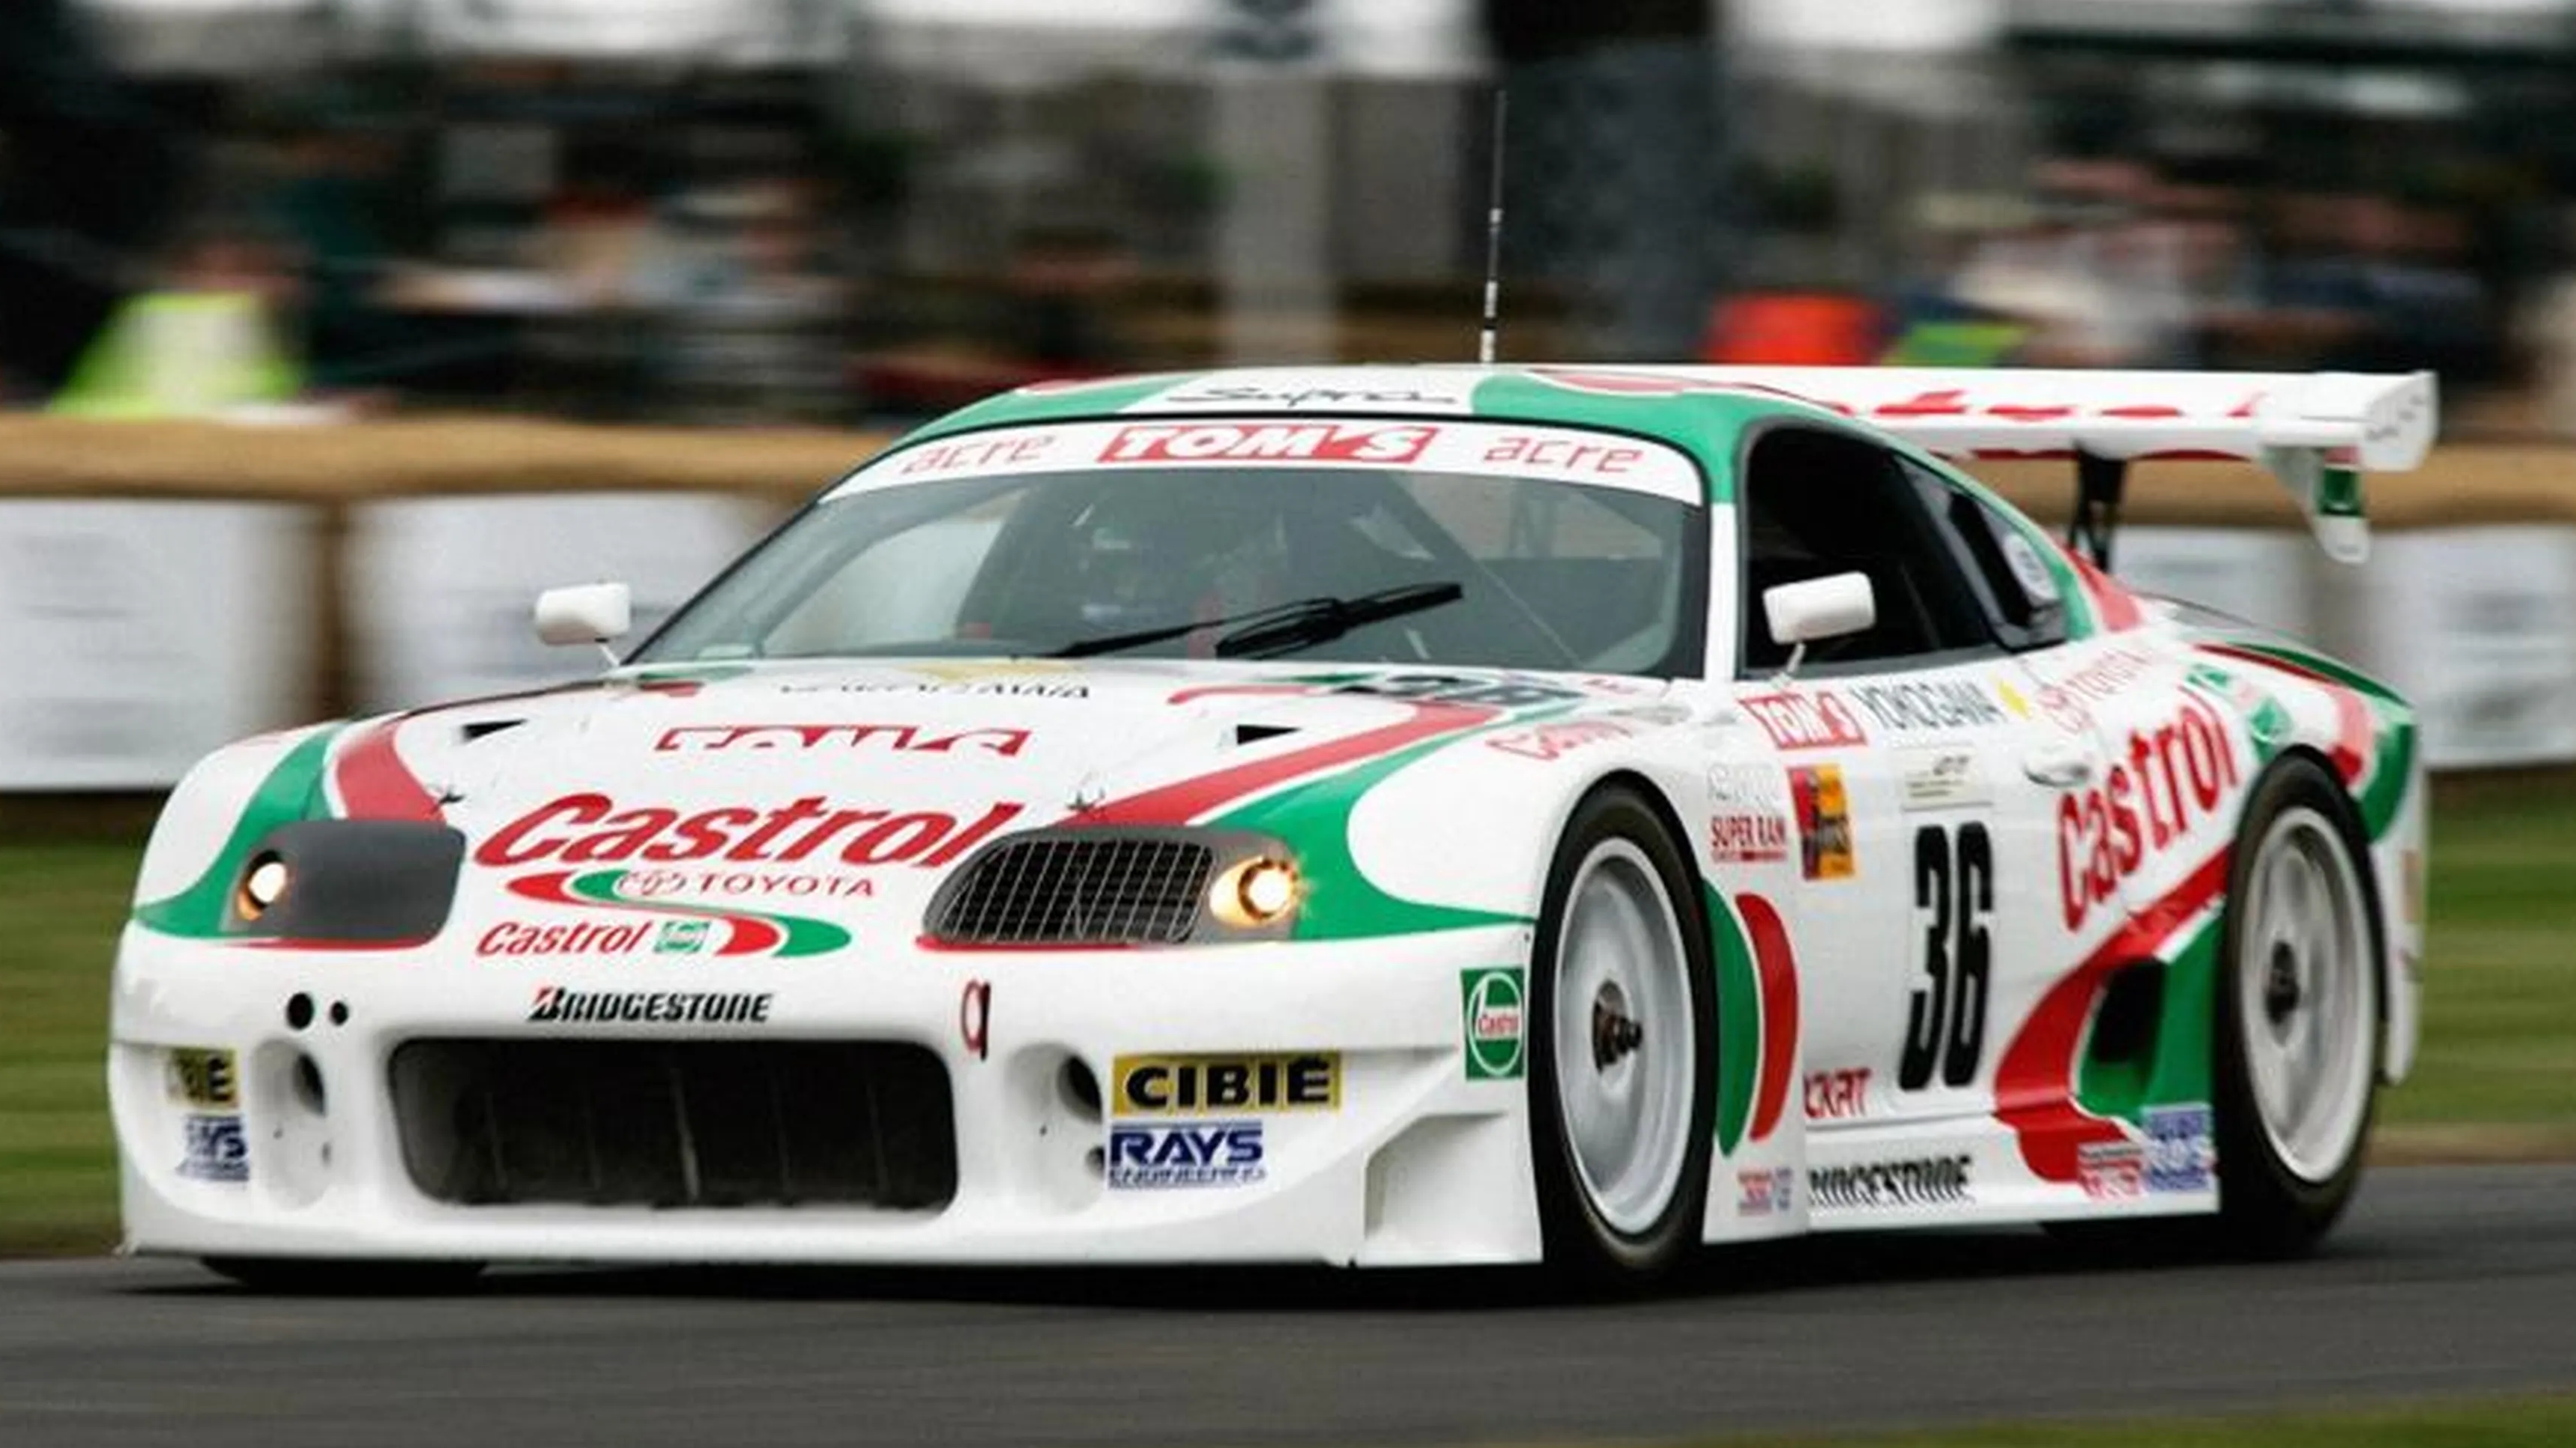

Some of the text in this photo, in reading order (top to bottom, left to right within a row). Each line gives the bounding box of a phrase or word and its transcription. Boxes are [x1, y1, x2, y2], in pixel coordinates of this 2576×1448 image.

[901, 434, 1056, 474] acre
[1484, 436, 1643, 473] acre
[2059, 685, 2238, 931] Castrol
[473, 793, 1024, 867] Castrol
[694, 871, 875, 897] TOYOTA
[475, 920, 652, 957] Castrol
[1899, 821, 1994, 1091] 36
[528, 984, 774, 1023] BRIDGESTONE
[1111, 1129, 1263, 1163] RAYS
